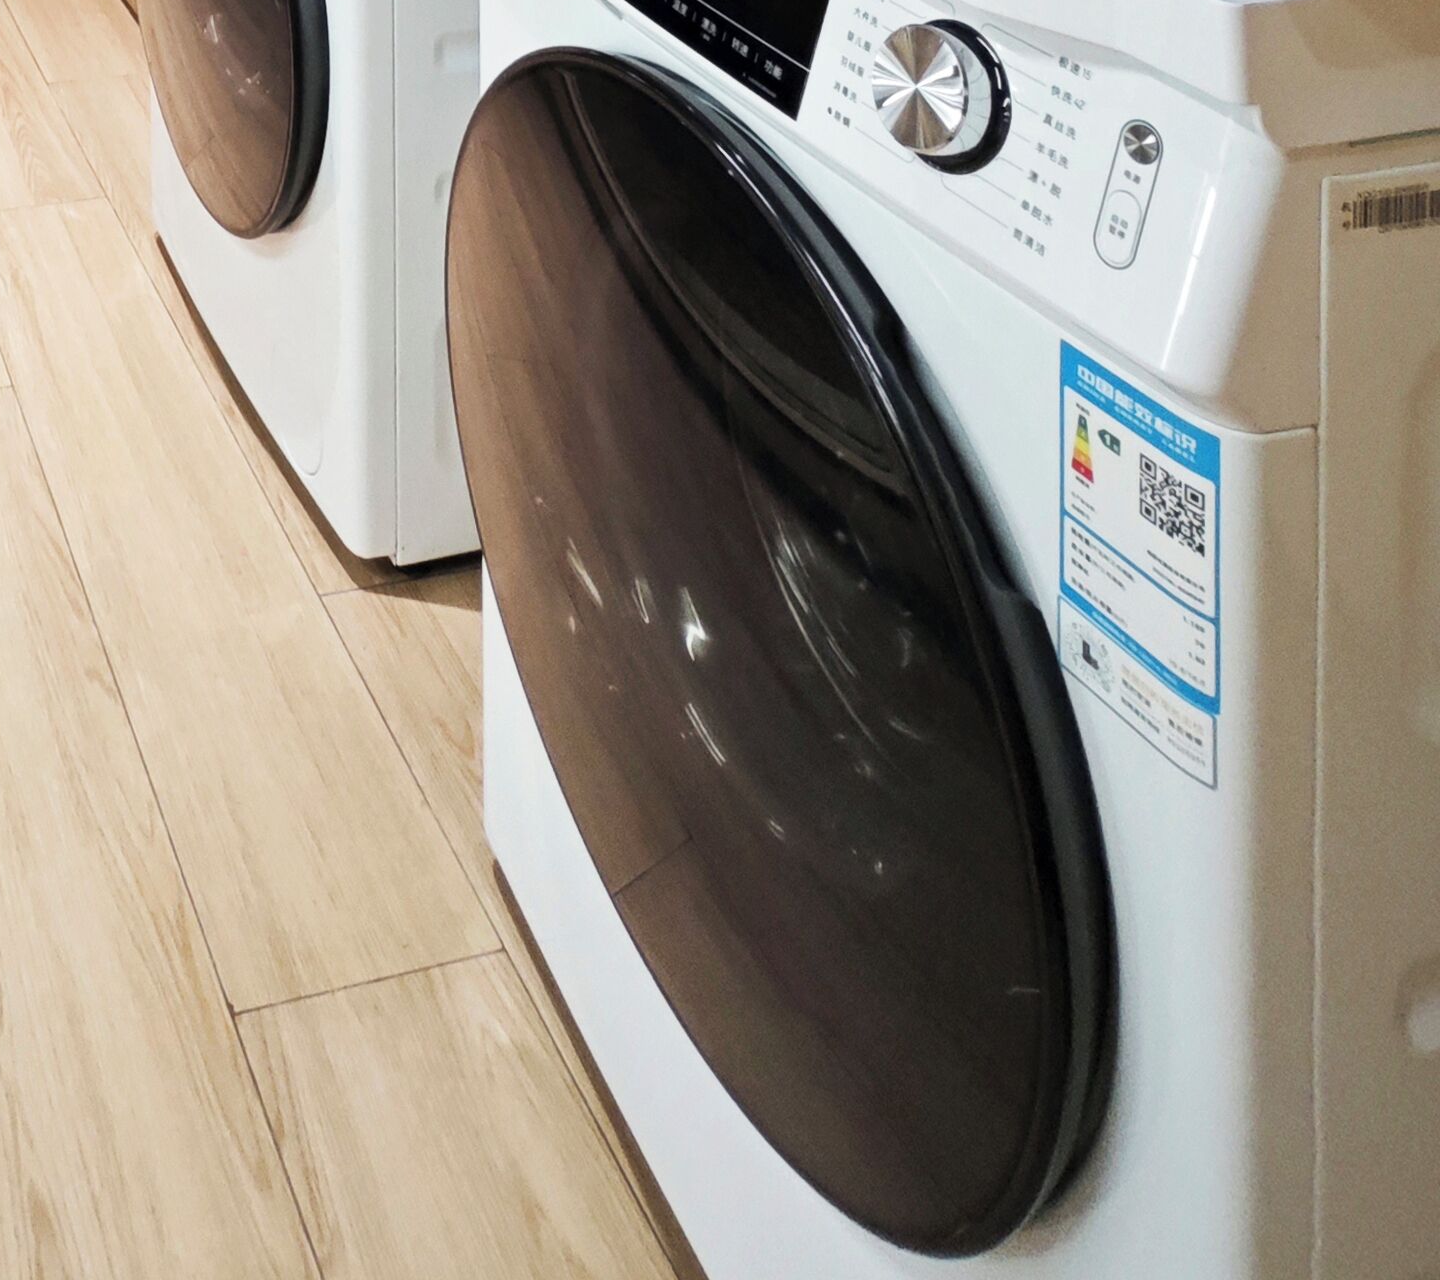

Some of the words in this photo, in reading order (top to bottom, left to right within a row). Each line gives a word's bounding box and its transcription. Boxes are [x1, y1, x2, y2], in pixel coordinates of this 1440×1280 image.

[763, 59, 783, 81] 功能
[1077, 363, 1197, 455] 中国能效标识
